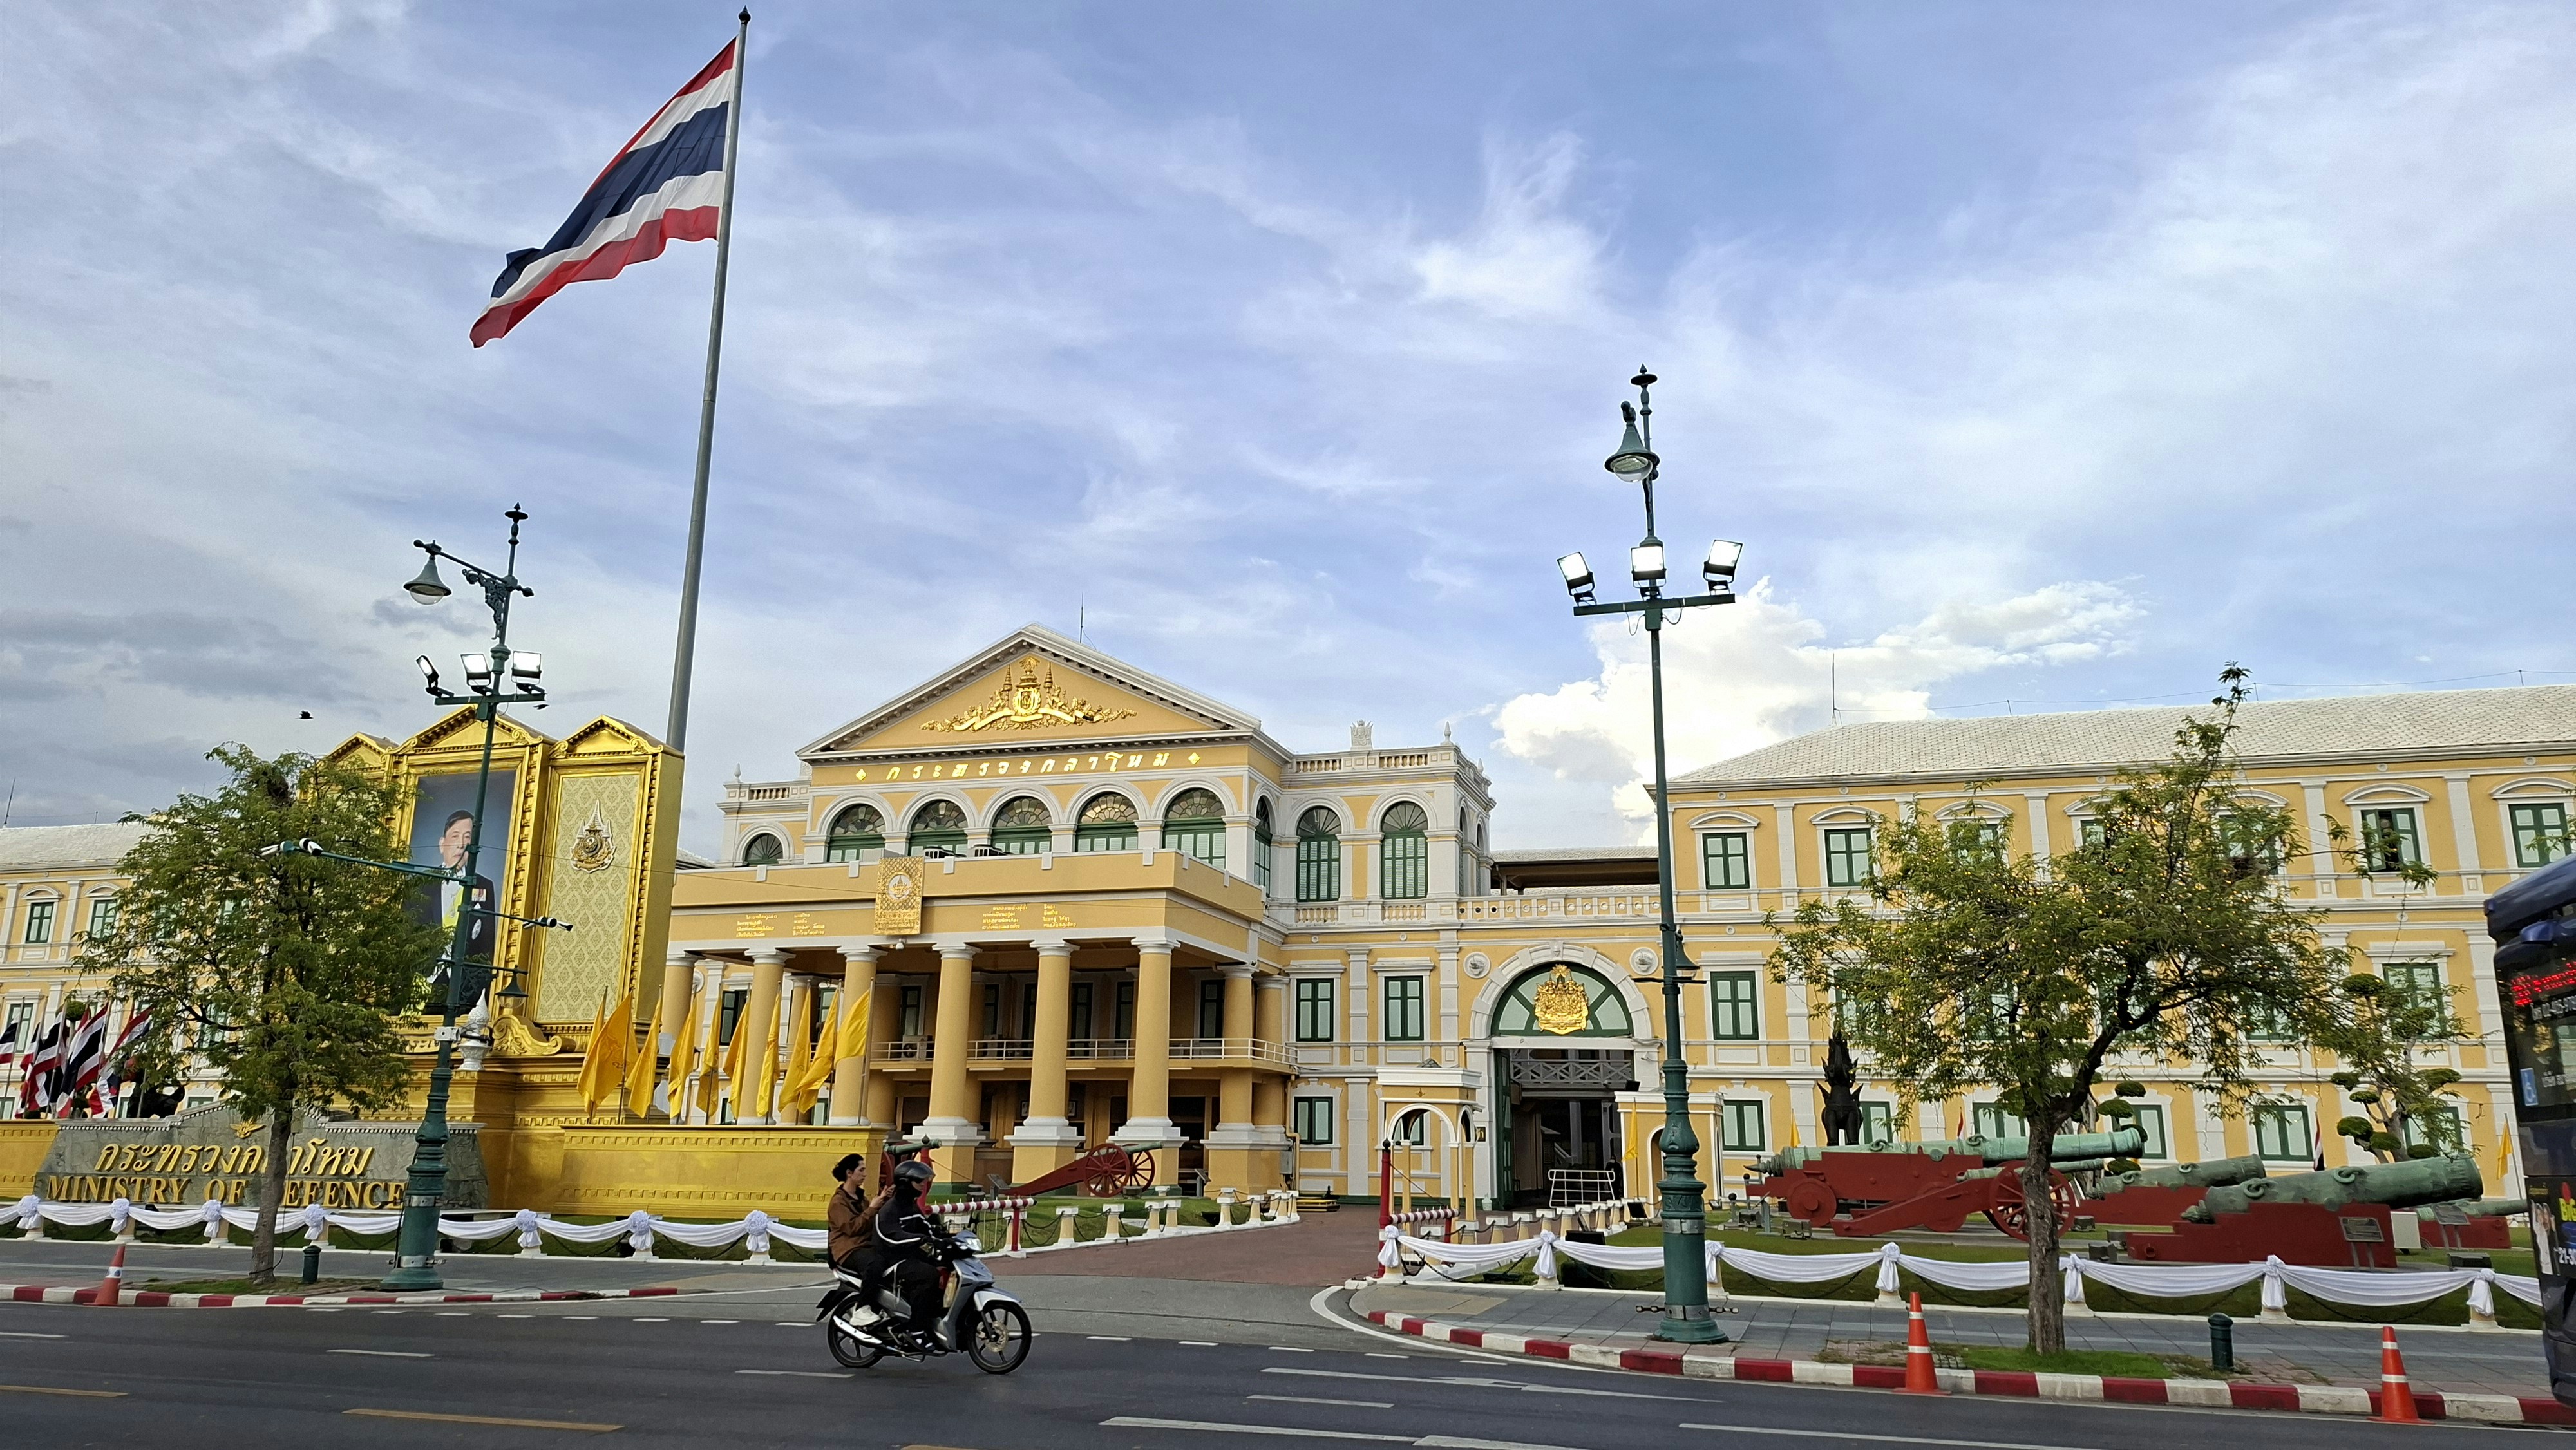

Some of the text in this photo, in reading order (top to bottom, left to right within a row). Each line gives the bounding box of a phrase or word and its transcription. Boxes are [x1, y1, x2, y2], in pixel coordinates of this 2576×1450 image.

[886, 751, 1170, 780] กระทรวงกลาโหม
[95, 1137, 375, 1176] กระทรวงกาโหม
[47, 1175, 408, 1209] MINISTRY OF EFENCE
